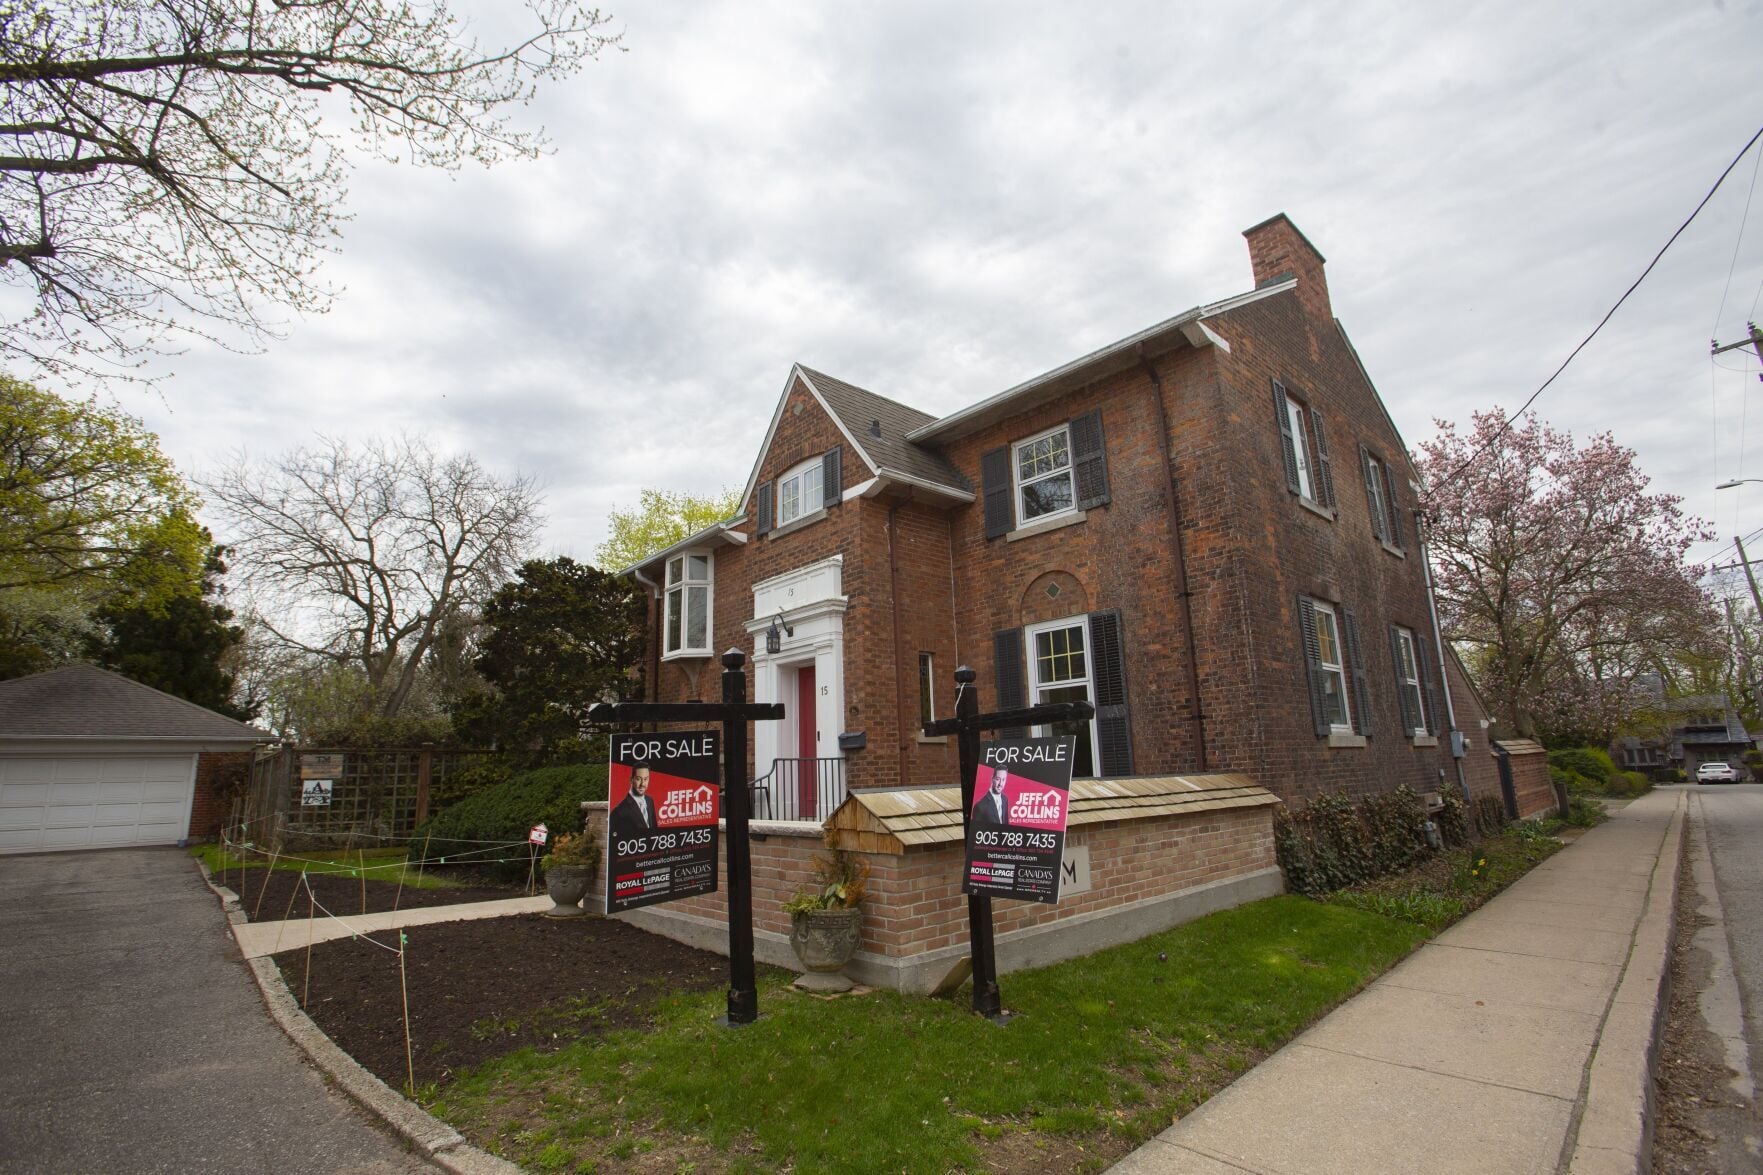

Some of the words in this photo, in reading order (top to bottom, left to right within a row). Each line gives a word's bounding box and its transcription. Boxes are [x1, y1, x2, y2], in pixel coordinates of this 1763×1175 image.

[787, 588, 794, 597] 15
[820, 685, 828, 696] 15
[620, 741, 661, 761] FOR
[665, 738, 714, 758] SALE
[985, 747, 1019, 764] FOR
[1022, 744, 1067, 762] SALE
[663, 789, 693, 805] JEFF
[1015, 792, 1044, 805] JEFF
[658, 801, 713, 819] COLLINS
[1010, 805, 1060, 819] COLLINS
[617, 837, 647, 856] 905
[650, 833, 676, 851] 788
[680, 828, 711, 847] 7435
[975, 831, 999, 845] 905
[1001, 832, 1022, 847] 788
[1026, 833, 1056, 848] 7435
[636, 853, 694, 868] bettercallcollins.com
[987, 852, 1038, 862] bettercallcollins.com
[674, 863, 711, 877] CANADA'S
[970, 867, 990, 875] ROYAL
[991, 868, 1015, 878] LePAGE
[1017, 868, 1053, 879] CANADA'S
[616, 879, 642, 890] ROYAL
[642, 873, 670, 885] LePAGE
